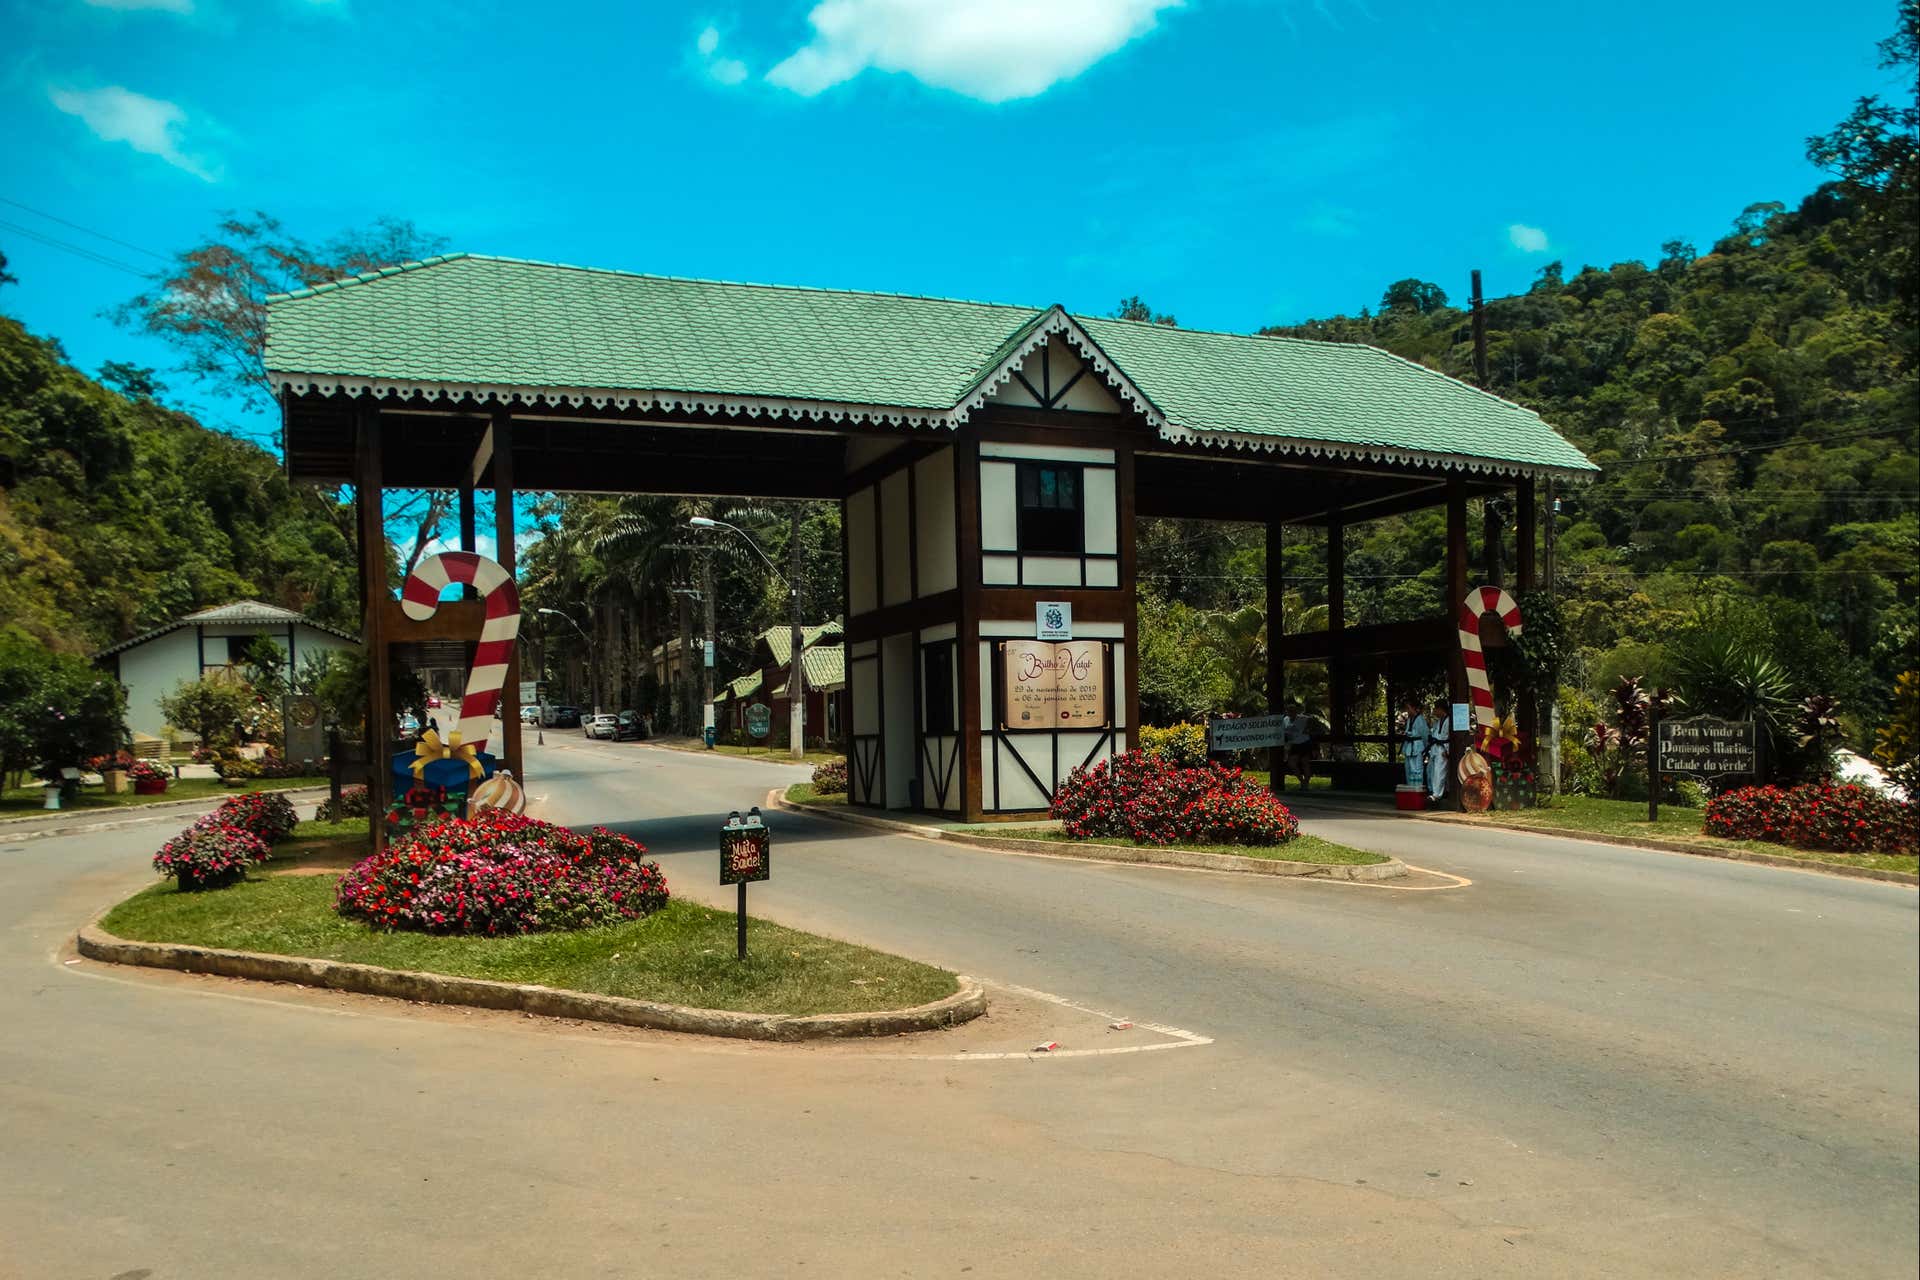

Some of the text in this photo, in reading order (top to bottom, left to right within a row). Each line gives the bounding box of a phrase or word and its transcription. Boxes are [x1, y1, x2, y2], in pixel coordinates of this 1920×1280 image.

[1671, 724, 1743, 737] Bem vindo a
[1661, 741, 1710, 755] Domingos
[1704, 760, 1716, 770] do
